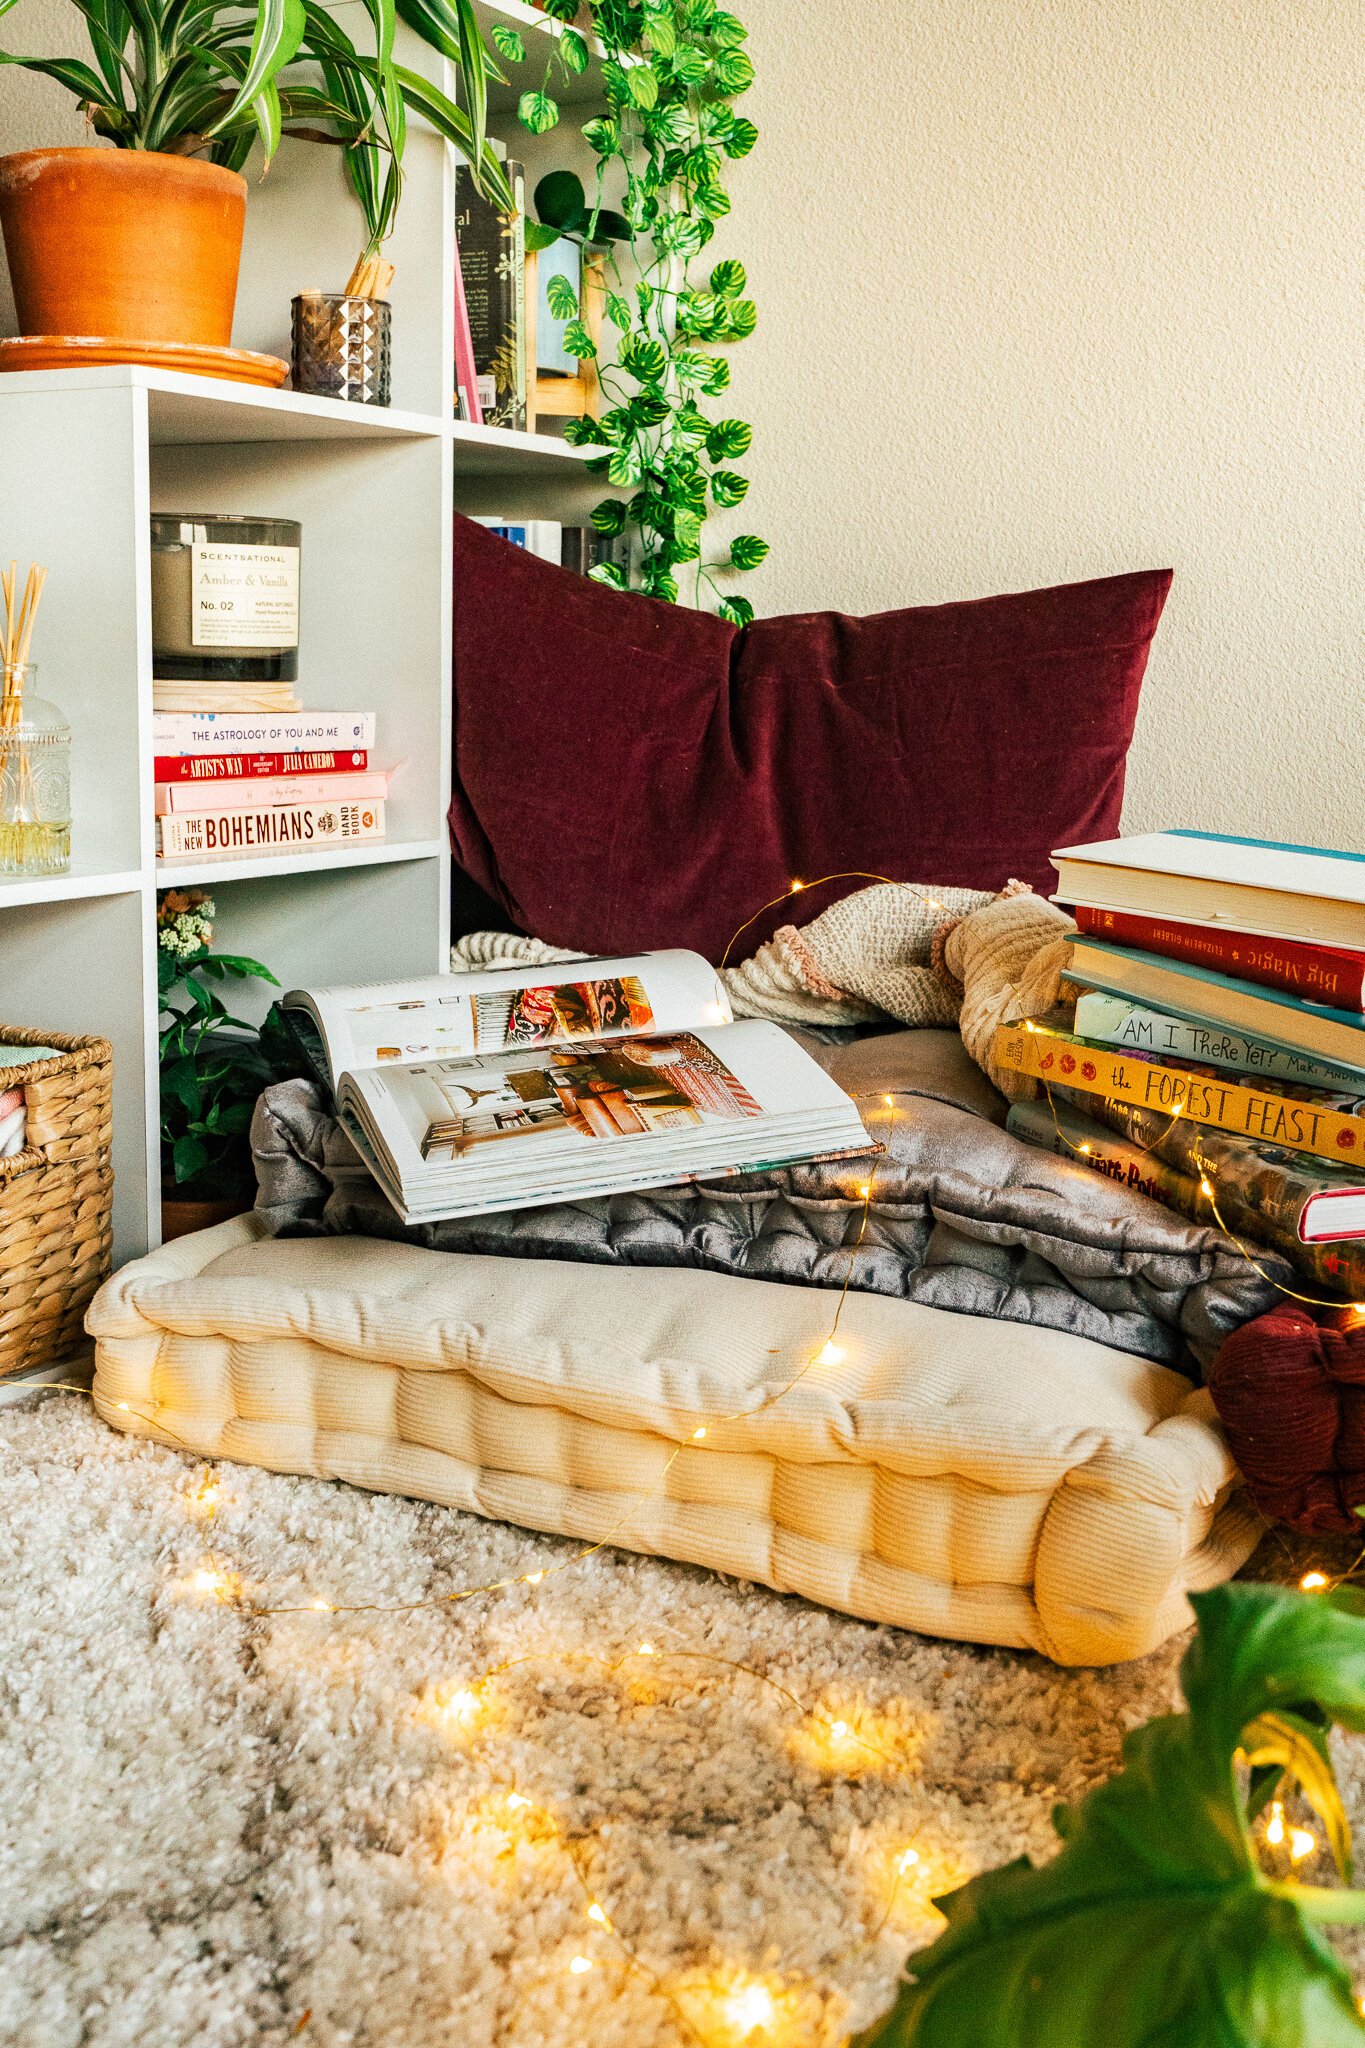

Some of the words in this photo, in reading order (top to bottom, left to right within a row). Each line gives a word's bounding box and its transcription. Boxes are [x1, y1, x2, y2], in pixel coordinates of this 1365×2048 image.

[200, 552, 286, 563] SCENTSATIONAL
[199, 572, 242, 585] Amber
[245, 575, 255, 586] &
[259, 575, 288, 587] Vanilla
[200, 601, 217, 610] No.
[220, 601, 234, 611] 02
[192, 731, 210, 741] THE
[213, 729, 267, 740] ASTROLOGY
[269, 728, 281, 739] OF
[285, 728, 302, 738] YOU
[305, 727, 323, 737] AND
[326, 727, 338, 736] ME
[190, 758, 225, 778] ARTIST'S
[225, 757, 243, 775] WAY
[283, 754, 303, 773] JULIA
[304, 752, 336, 770] CAMERON
[186, 819, 202, 834] THE
[206, 810, 314, 848] BOHEMIANS
[341, 806, 350, 837] HAND
[350, 805, 360, 835] BOOK
[184, 836, 203, 850] NEW
[1152, 928, 1183, 945] GILBERT
[1184, 936, 1223, 957] ELIZABETH
[1247, 951, 1303, 983] Magic
[1307, 963, 1338, 993] Big
[1122, 1019, 1153, 1045] AM
[1162, 1024, 1180, 1049] I
[1006, 1041, 1016, 1058] ERIN
[1013, 1038, 1025, 1066] GLEESON
[1111, 1066, 1132, 1089] the
[1145, 1070, 1234, 1122] FOREST
[1245, 1096, 1326, 1147] FEAST
[1012, 1119, 1045, 1140] ROWLING
[1203, 1157, 1218, 1174] THE
